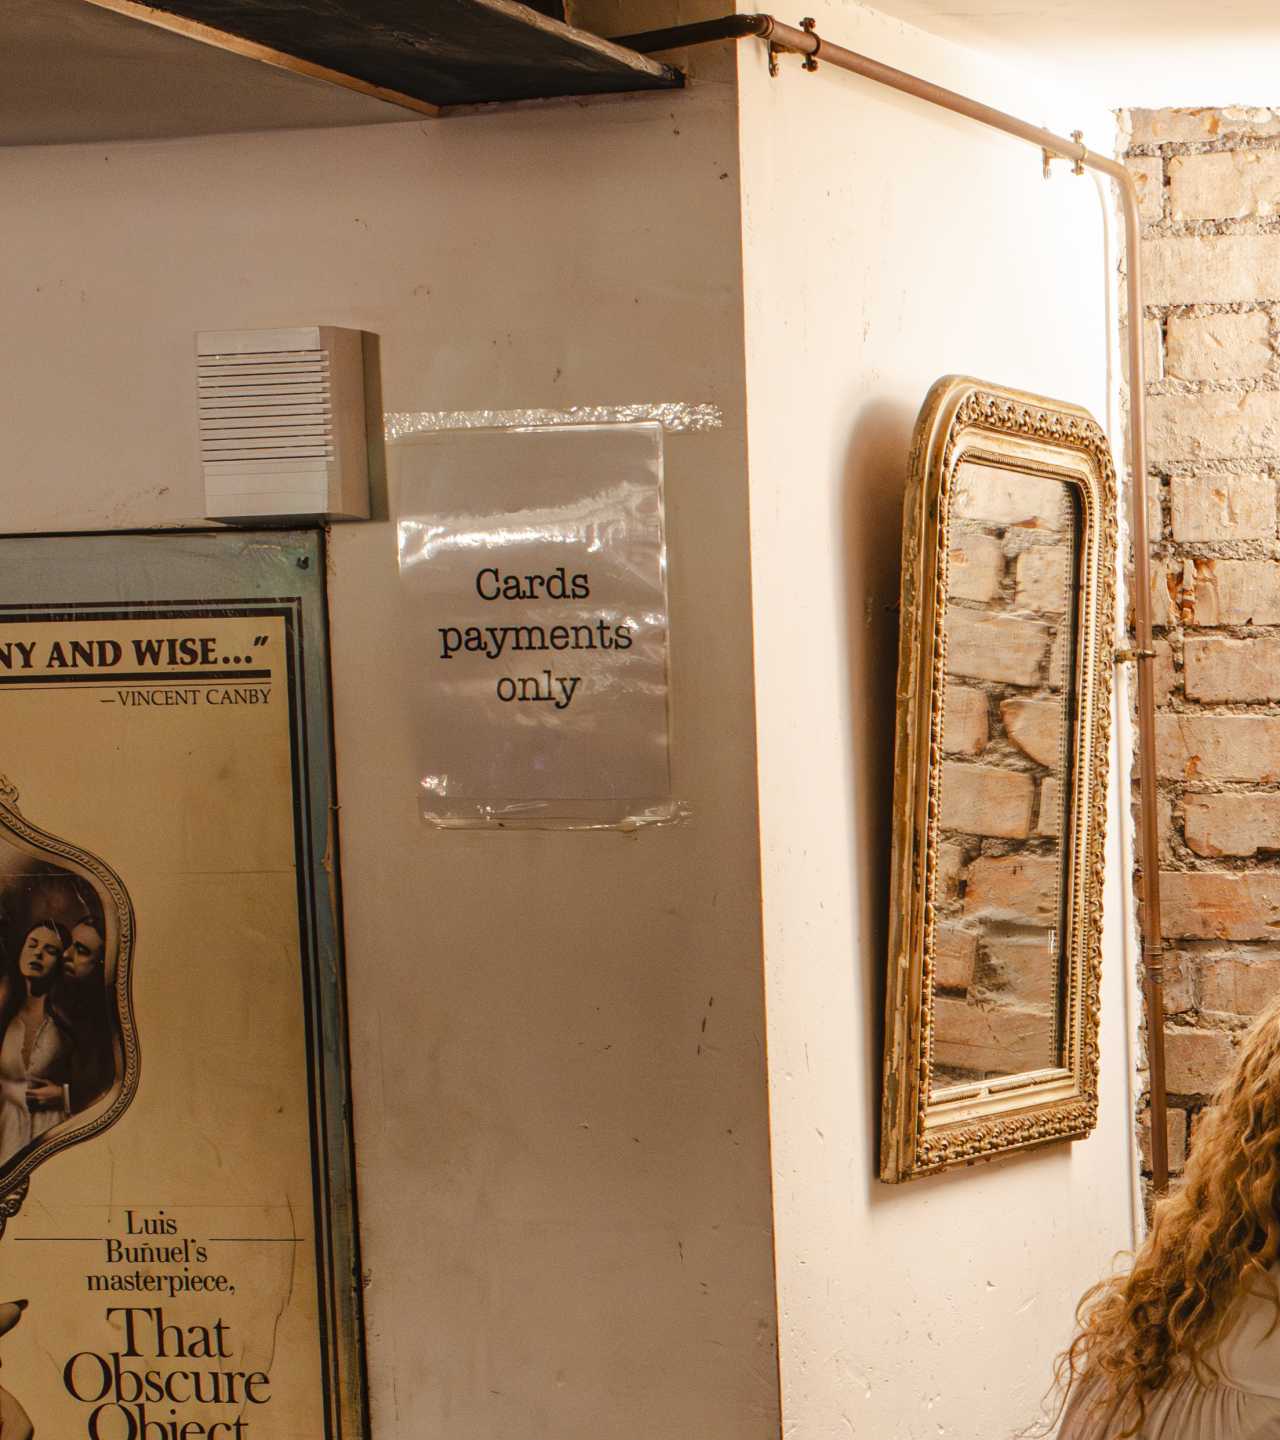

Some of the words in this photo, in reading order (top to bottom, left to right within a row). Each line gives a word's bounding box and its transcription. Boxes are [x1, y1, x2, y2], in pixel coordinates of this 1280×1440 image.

[475, 567, 590, 601] Cards
[46, 640, 122, 668] AND
[438, 619, 633, 659] payments
[206, 688, 272, 705] CANBY
[496, 670, 581, 709] only
[124, 1210, 178, 1235] Luis
[87, 1267, 235, 1297] masterpiece,
[106, 1307, 234, 1358] That
[63, 1351, 272, 1404] Obscure
